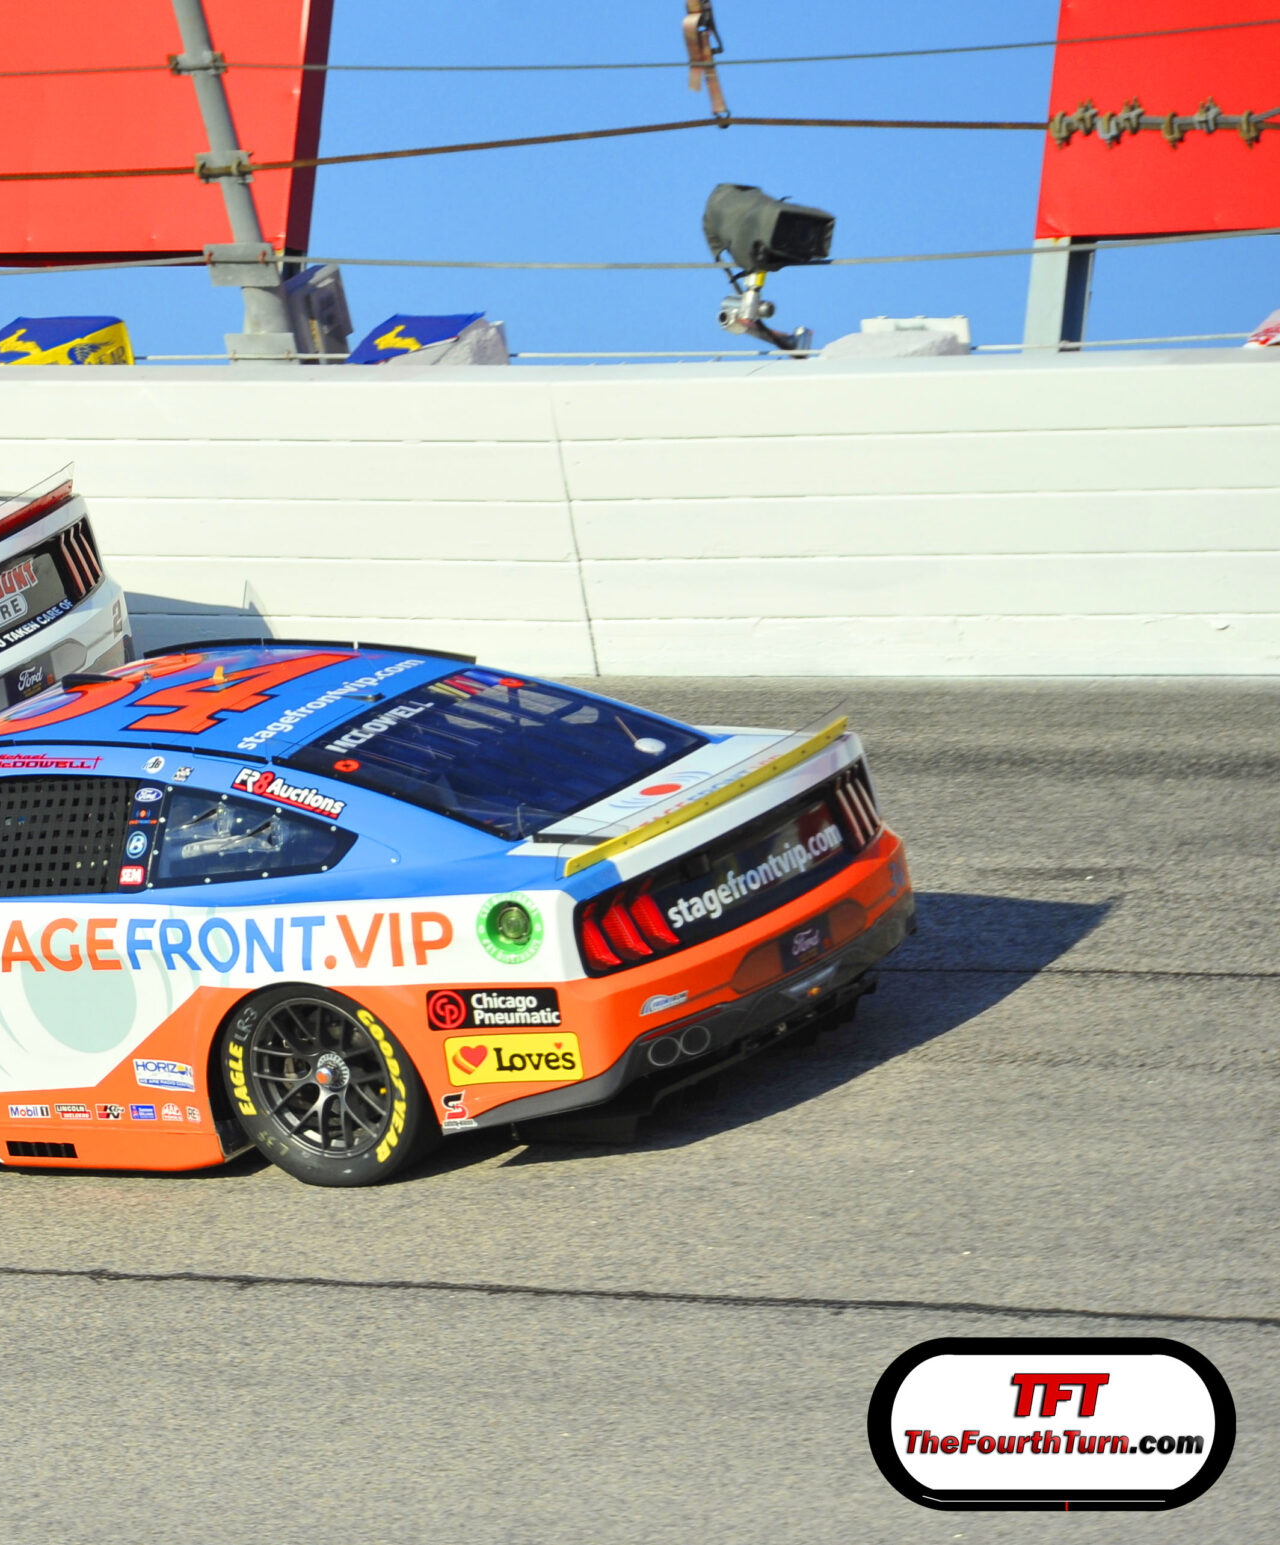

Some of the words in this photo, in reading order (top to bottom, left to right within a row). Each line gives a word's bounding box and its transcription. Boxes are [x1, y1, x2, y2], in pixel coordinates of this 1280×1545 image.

[3, 620, 40, 646] TAKEN
[37, 605, 63, 626] CARE
[59, 598, 73, 613] OF
[18, 666, 44, 691] Ford
[237, 658, 426, 751] stagefrontvip.com
[233, 767, 346, 816] FR8Auctions
[121, 867, 142, 883] SEM
[667, 823, 843, 929] stagefrontvip.com
[471, 992, 538, 1012] Chicago
[473, 1008, 562, 1026] Pneumatic
[134, 1060, 194, 1078] HORIZON
[228, 1041, 258, 1116] EAGLE
[356, 1008, 408, 1164] GOODYEAR
[10, 1105, 39, 1117] Mobil
